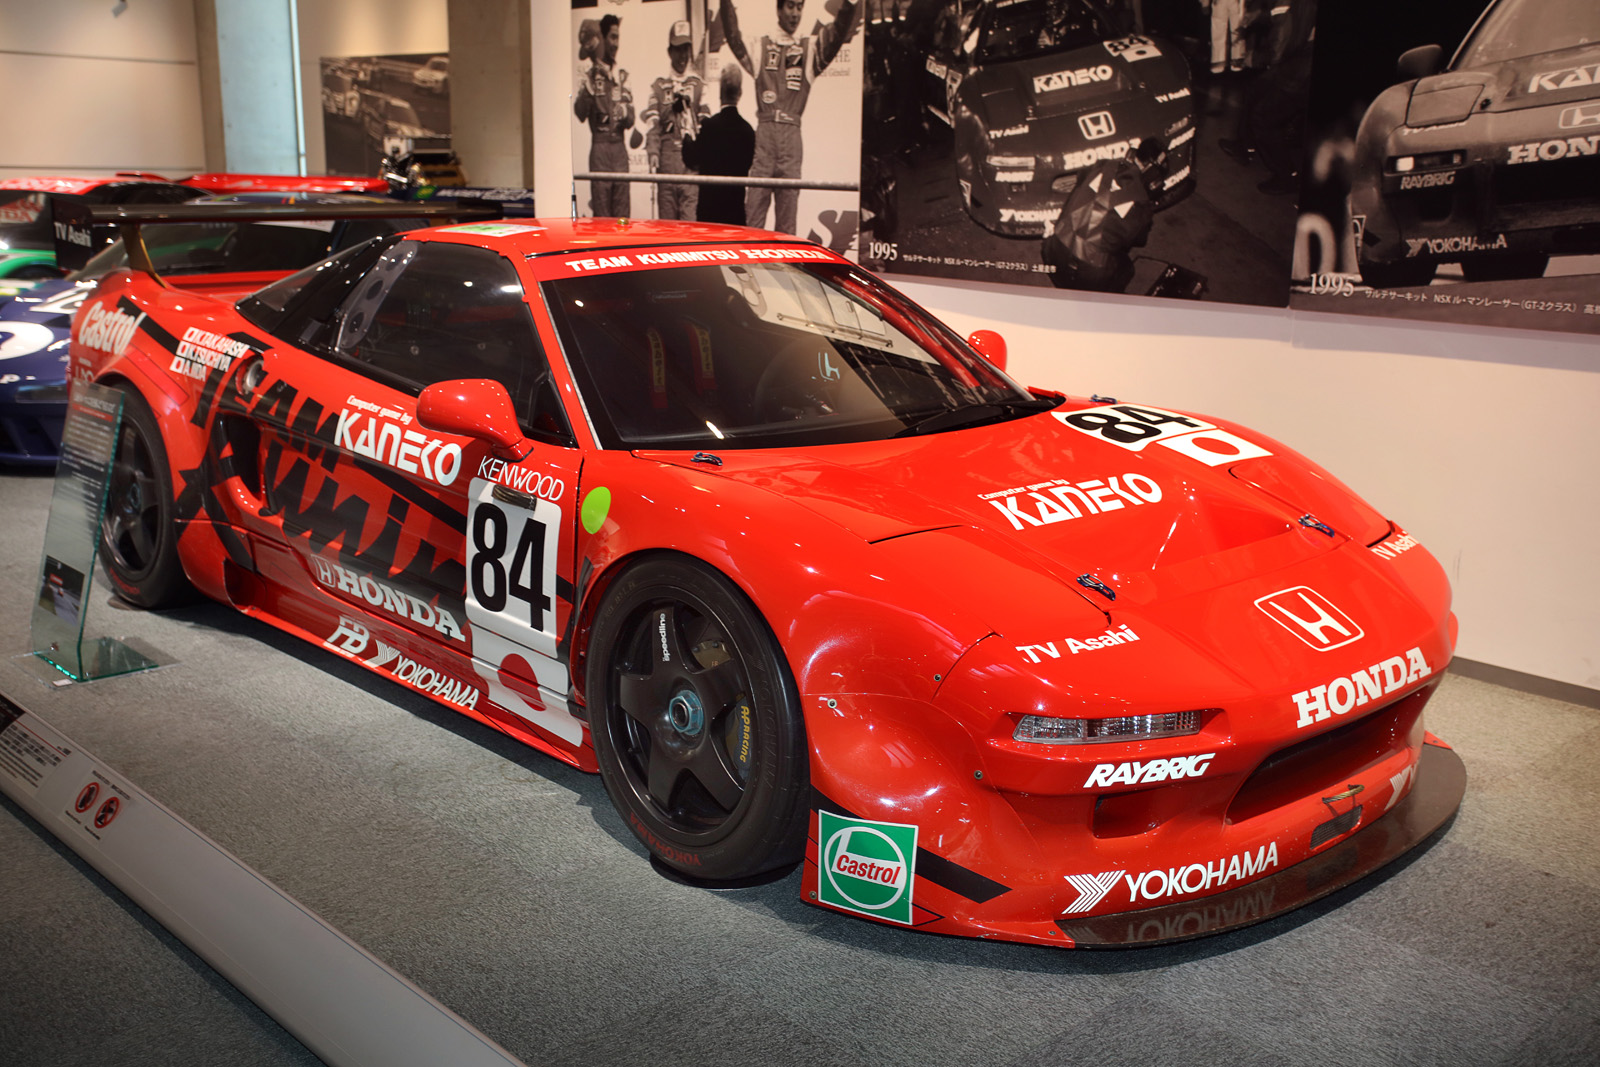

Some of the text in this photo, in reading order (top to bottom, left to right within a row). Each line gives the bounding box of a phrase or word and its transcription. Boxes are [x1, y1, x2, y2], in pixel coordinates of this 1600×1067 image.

[1033, 64, 1113, 94] KANEKO
[1528, 64, 1600, 93] KA
[1400, 171, 1456, 190] RAYBRIG
[54, 222, 92, 247] TV Asahi
[868, 241, 898, 261] 1995
[565, 248, 835, 272] TEAM KUNIMITSU HONDA
[1310, 273, 1354, 297] 1995
[1365, 289, 1428, 302] サルテサーキット
[78, 300, 147, 355] Castrol
[347, 395, 413, 426] Computer game by
[1065, 405, 1202, 444] 84
[334, 408, 462, 486] KANEKO
[477, 455, 565, 502] KENWOOD
[977, 478, 1071, 501] Computer game by
[988, 472, 1163, 531] KANEKO
[471, 502, 551, 632] 84
[334, 564, 466, 643] HONDA
[1015, 624, 1141, 664] TV Asahi
[391, 654, 480, 711] YOKOHAMA
[1291, 646, 1432, 728] HONDA
[1083, 753, 1216, 788] RAYBRIG
[836, 853, 902, 885] Castrol
[1125, 841, 1279, 902] YOKOHAMA
